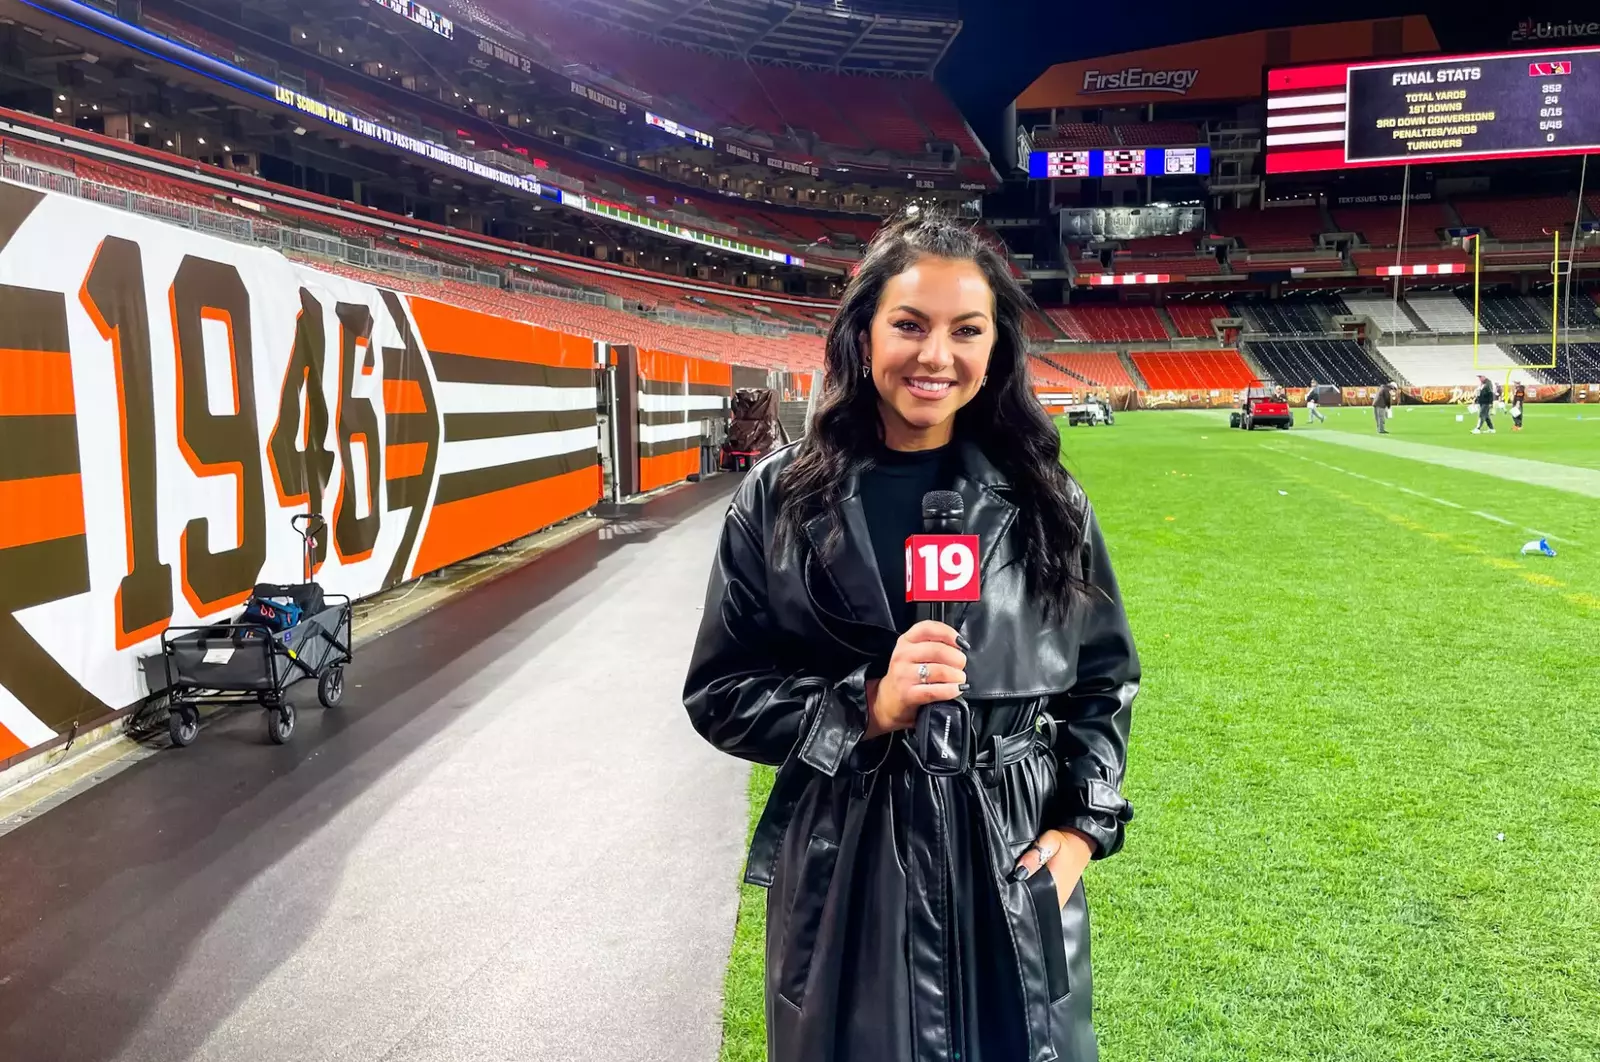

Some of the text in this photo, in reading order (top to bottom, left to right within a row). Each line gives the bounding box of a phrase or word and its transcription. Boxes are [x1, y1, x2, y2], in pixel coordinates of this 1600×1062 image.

[520, 58, 531, 74] 32
[1083, 68, 1199, 90] FirstEnergy
[1392, 67, 1481, 86] FINAL STATS
[1541, 84, 1562, 93] 352
[1405, 90, 1467, 103] TOTAL YARDS
[1544, 96, 1559, 105] 24
[275, 85, 294, 106] LAST
[296, 94, 327, 118] SCORING
[328, 105, 348, 127] PLAY:
[619, 101, 627, 115] 42
[1408, 102, 1463, 115] 1ST DOWNS
[1376, 112, 1495, 129] 3RD DOWN CONVERSIONS
[1539, 120, 1563, 130] 5/45
[1392, 125, 1478, 140] PENALTIES/YARDS
[1546, 133, 1555, 142] 0
[1406, 139, 1463, 151] TURNOVERS
[79, 234, 381, 651] 1946
[918, 543, 975, 591] 19
